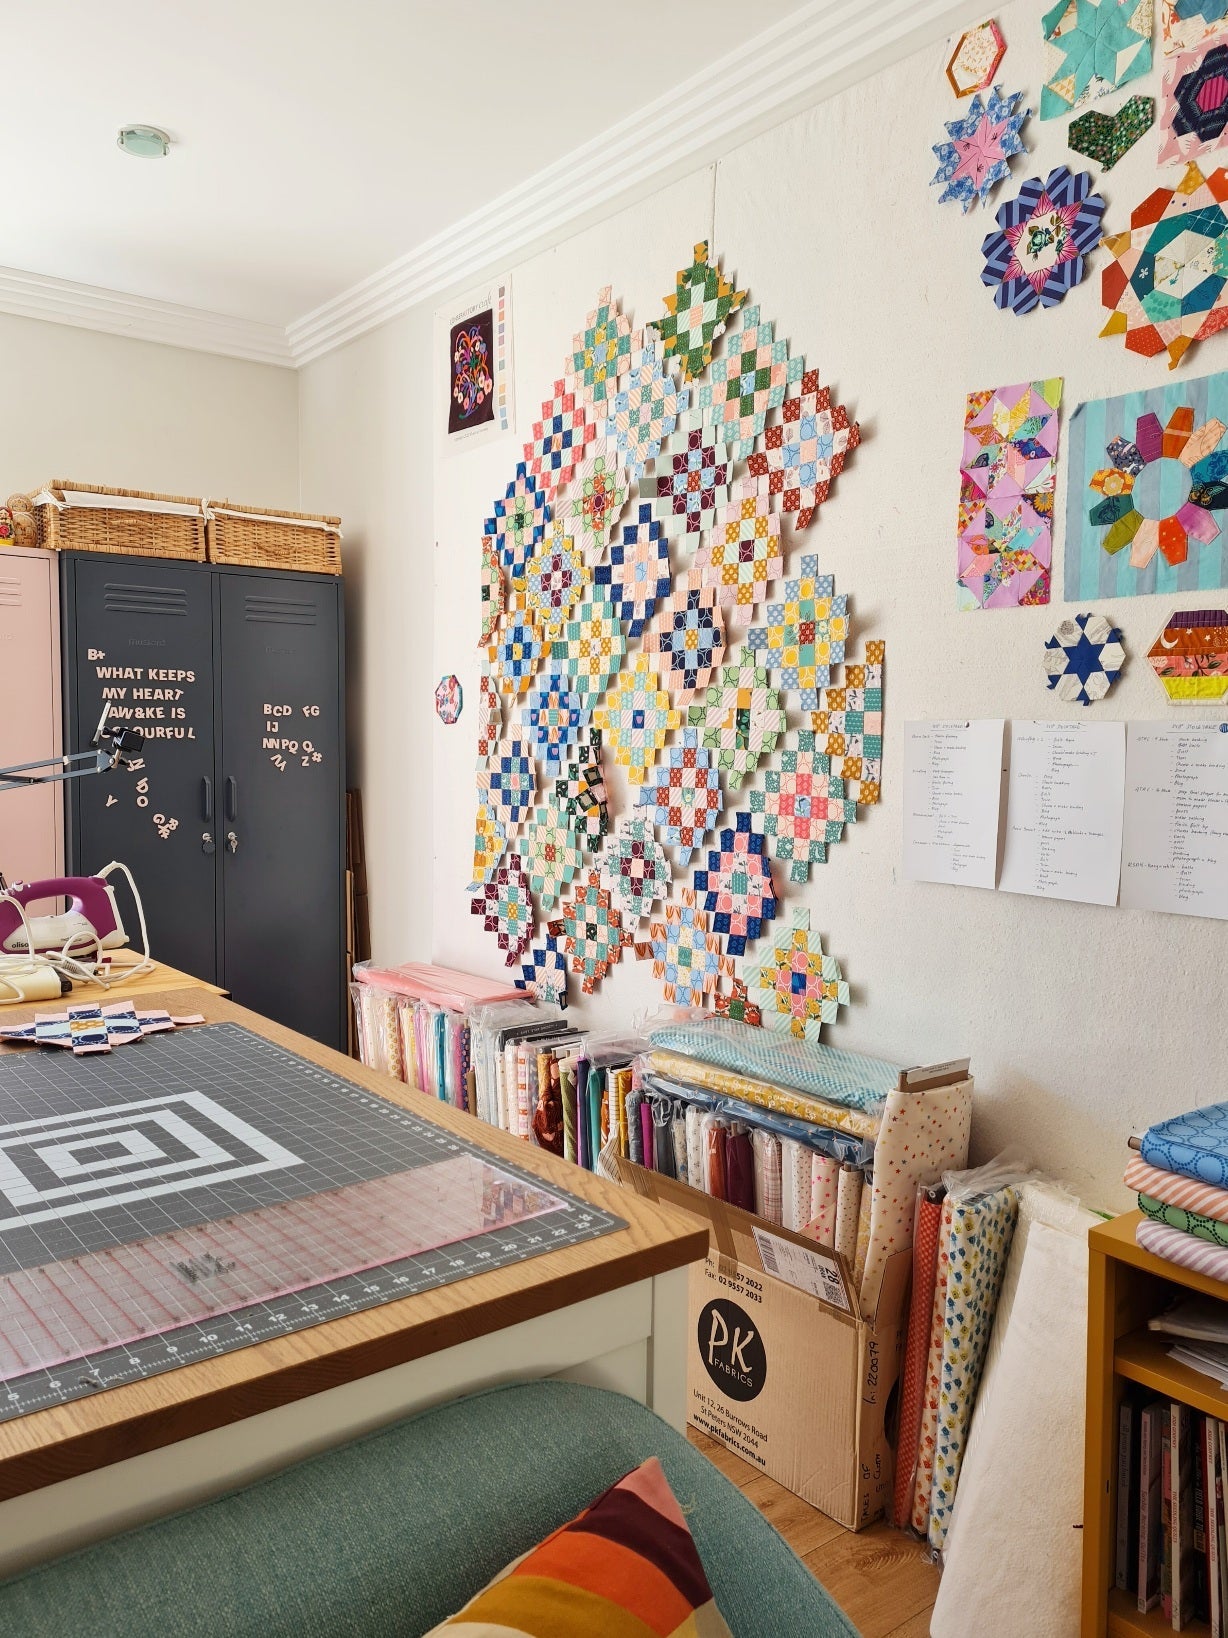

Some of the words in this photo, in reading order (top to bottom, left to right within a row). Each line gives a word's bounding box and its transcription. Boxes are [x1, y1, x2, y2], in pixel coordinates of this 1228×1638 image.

[96, 666, 144, 680] WHAT
[148, 668, 196, 683] KEEPS
[102, 687, 127, 699] MY
[132, 688, 184, 701] HEART
[108, 706, 165, 720] AW&KE
[171, 707, 186, 719] IS
[263, 703, 292, 717] BCD
[302, 705, 320, 717] FG
[266, 721, 279, 733] IJ
[574, 1221, 591, 1230] 23
[551, 1227, 568, 1237] 22
[526, 1235, 543, 1244] 21
[501, 1243, 518, 1252] 20
[475, 1251, 491, 1260] 19
[448, 1259, 465, 1268] 18
[421, 1267, 436, 1276] 17
[392, 1276, 410, 1285] 16
[746, 1277, 763, 1292] 2022
[362, 1284, 380, 1294] 15
[704, 1269, 717, 1280] Fax:
[718, 1276, 727, 1286] 02
[728, 1281, 744, 1294] 9557
[745, 1289, 762, 1303] 2033
[332, 1294, 350, 1303] 14
[300, 1303, 319, 1312] 13
[267, 1313, 287, 1323] 12
[234, 1323, 253, 1333] 11
[198, 1334, 219, 1344] 10
[708, 1308, 754, 1373] PK
[128, 1357, 141, 1365] 8
[89, 1368, 101, 1377] 7
[714, 1358, 754, 1388] FABRICS
[49, 1380, 62, 1389] 6
[693, 1389, 706, 1403] Unit
[716, 1402, 725, 1414] 26
[725, 1409, 751, 1431] Burrows
[751, 1425, 768, 1442] Road
[700, 1405, 707, 1415] St
[707, 1409, 727, 1428] Peters
[727, 1422, 742, 1437] NSW
[743, 1432, 760, 1448] 2044
[693, 1413, 766, 1467] www.pkfabrics.com.au
